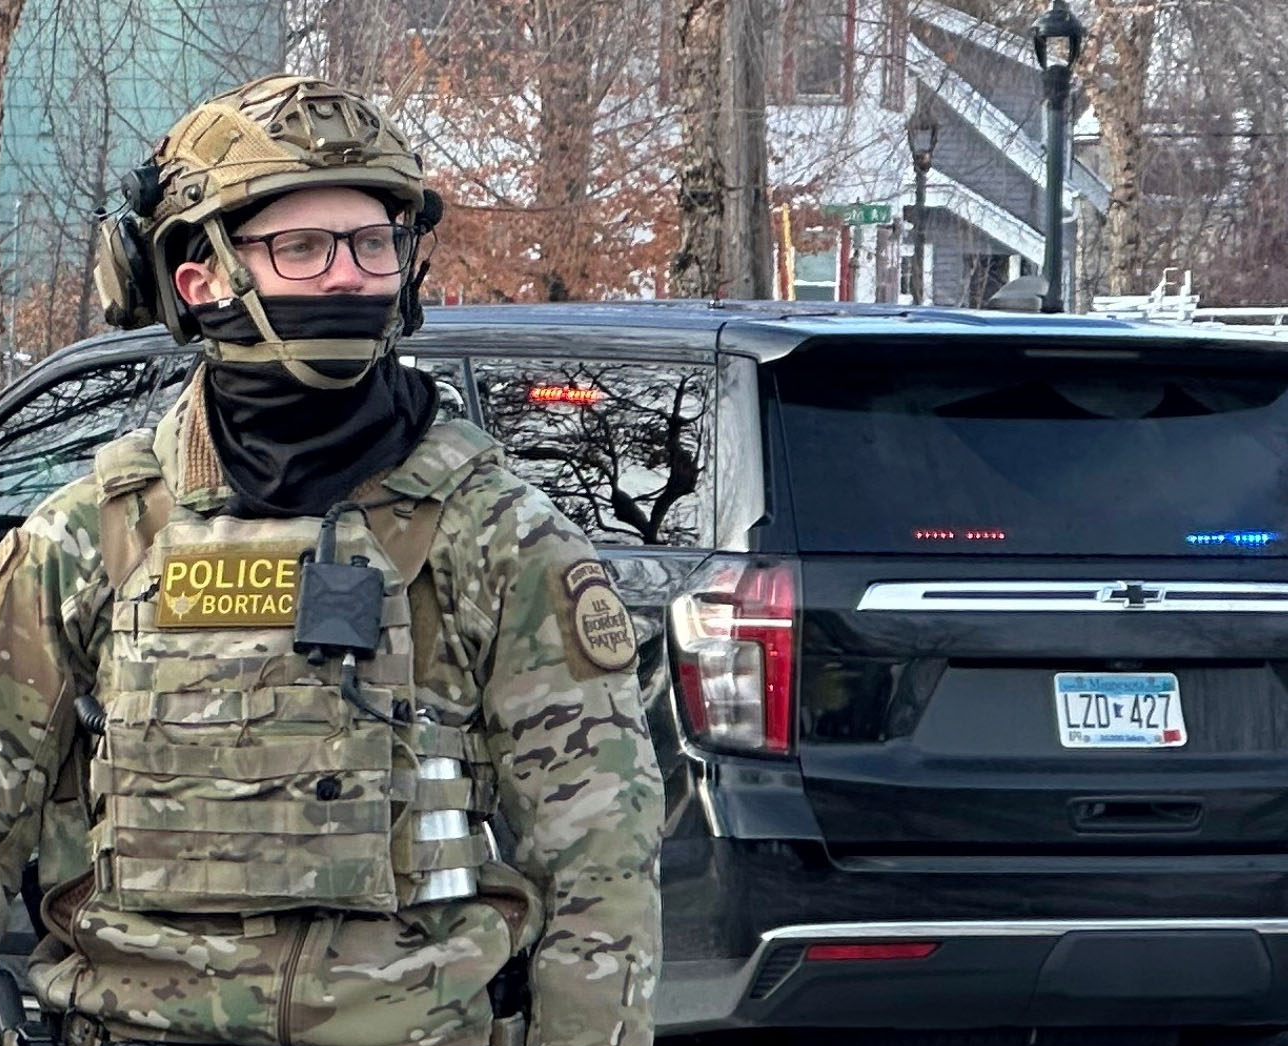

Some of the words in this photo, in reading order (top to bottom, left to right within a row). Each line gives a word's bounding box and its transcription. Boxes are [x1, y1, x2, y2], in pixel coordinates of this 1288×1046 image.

[166, 559, 298, 591] POLICE
[202, 594, 293, 614] BORTAC
[1064, 694, 1111, 728] LZD
[1130, 693, 1171, 728] 427
